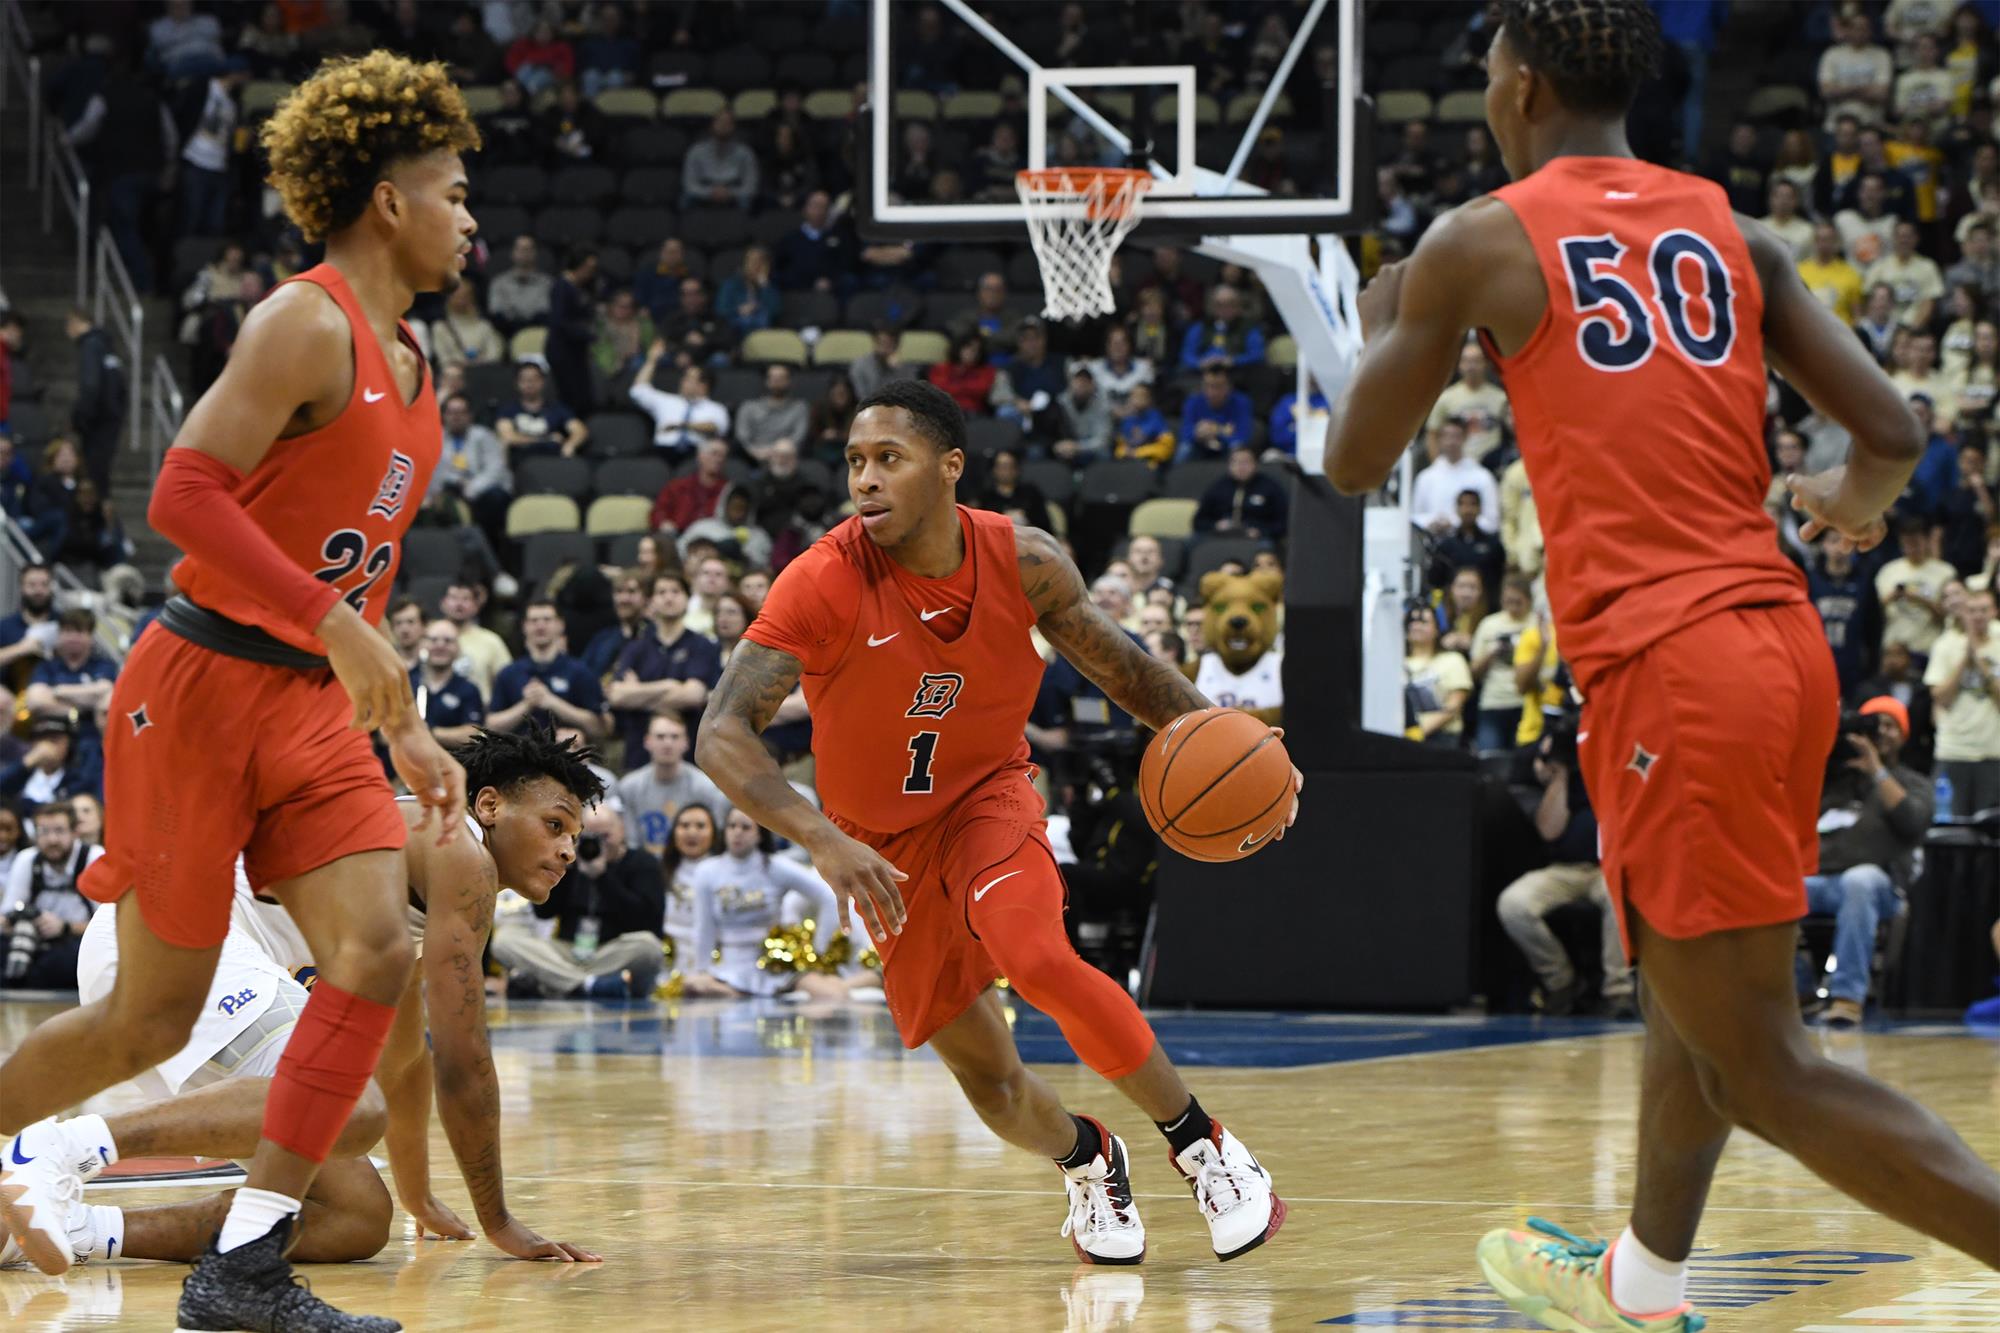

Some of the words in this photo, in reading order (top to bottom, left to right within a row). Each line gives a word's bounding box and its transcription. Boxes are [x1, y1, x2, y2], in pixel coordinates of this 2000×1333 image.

[1557, 228, 1736, 372] 50
[311, 528, 395, 617] 22
[902, 730, 940, 794] 1
[217, 987, 258, 1016] Pitt
